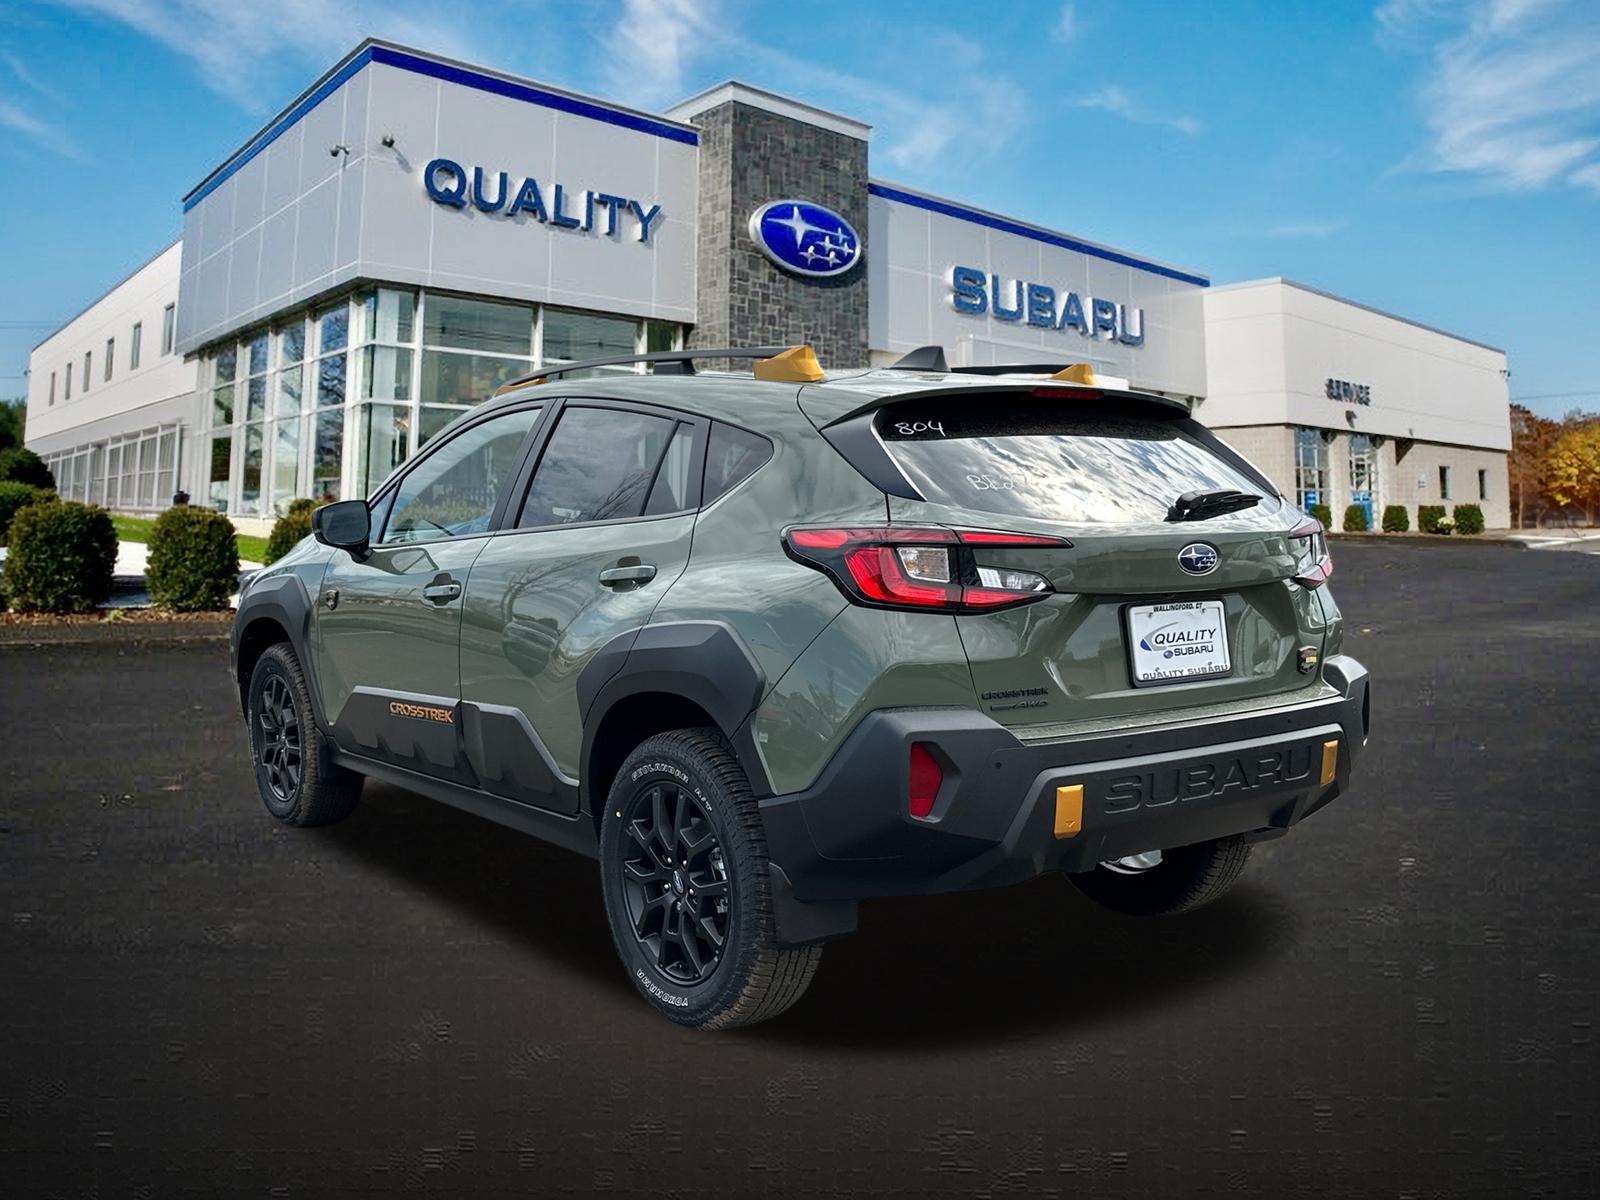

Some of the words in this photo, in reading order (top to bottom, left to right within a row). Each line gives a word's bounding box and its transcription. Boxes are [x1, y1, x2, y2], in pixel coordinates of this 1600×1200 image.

[424, 158, 662, 242] QUALITY
[950, 265, 1145, 346] SUBARU
[894, 420, 946, 437] 804
[1154, 628, 1216, 645] QUALITY
[1174, 645, 1213, 656] SUBARU
[1142, 669, 1184, 680] QUALITY
[1187, 664, 1228, 675] SUBARU
[981, 687, 1049, 700] CROSSTREK
[389, 702, 453, 723] CROSSTREK
[631, 763, 689, 782] GEOLANDAR
[1104, 745, 1312, 815] SUBARU
[636, 968, 689, 1007] YOKOHAMA
